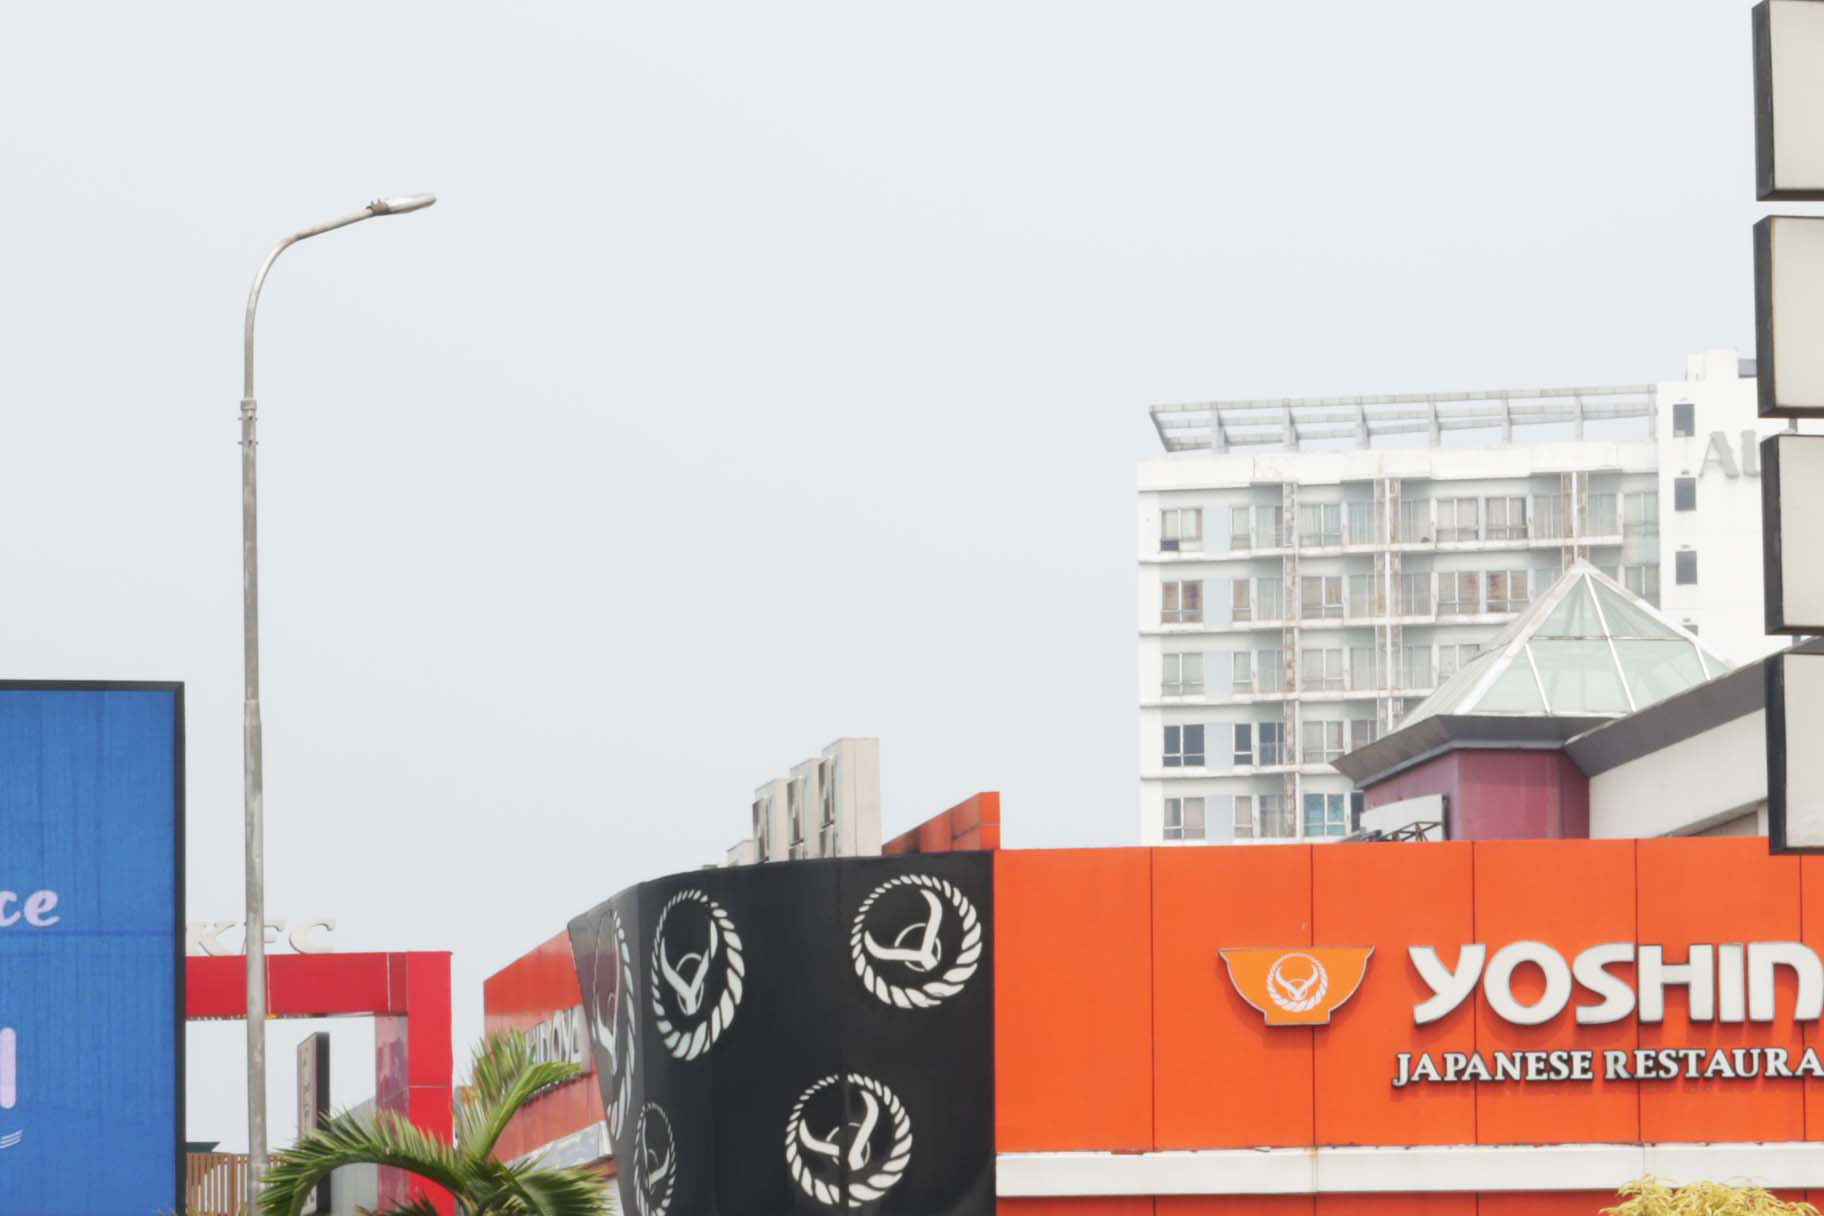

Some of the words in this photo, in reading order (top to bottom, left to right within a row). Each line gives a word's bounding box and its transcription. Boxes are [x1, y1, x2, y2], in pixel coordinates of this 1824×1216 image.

[1408, 940, 1824, 1026] YOSHIN
[1393, 1050, 1594, 1087] JAPANESE
[1604, 1048, 1824, 1081] RESTAURA
